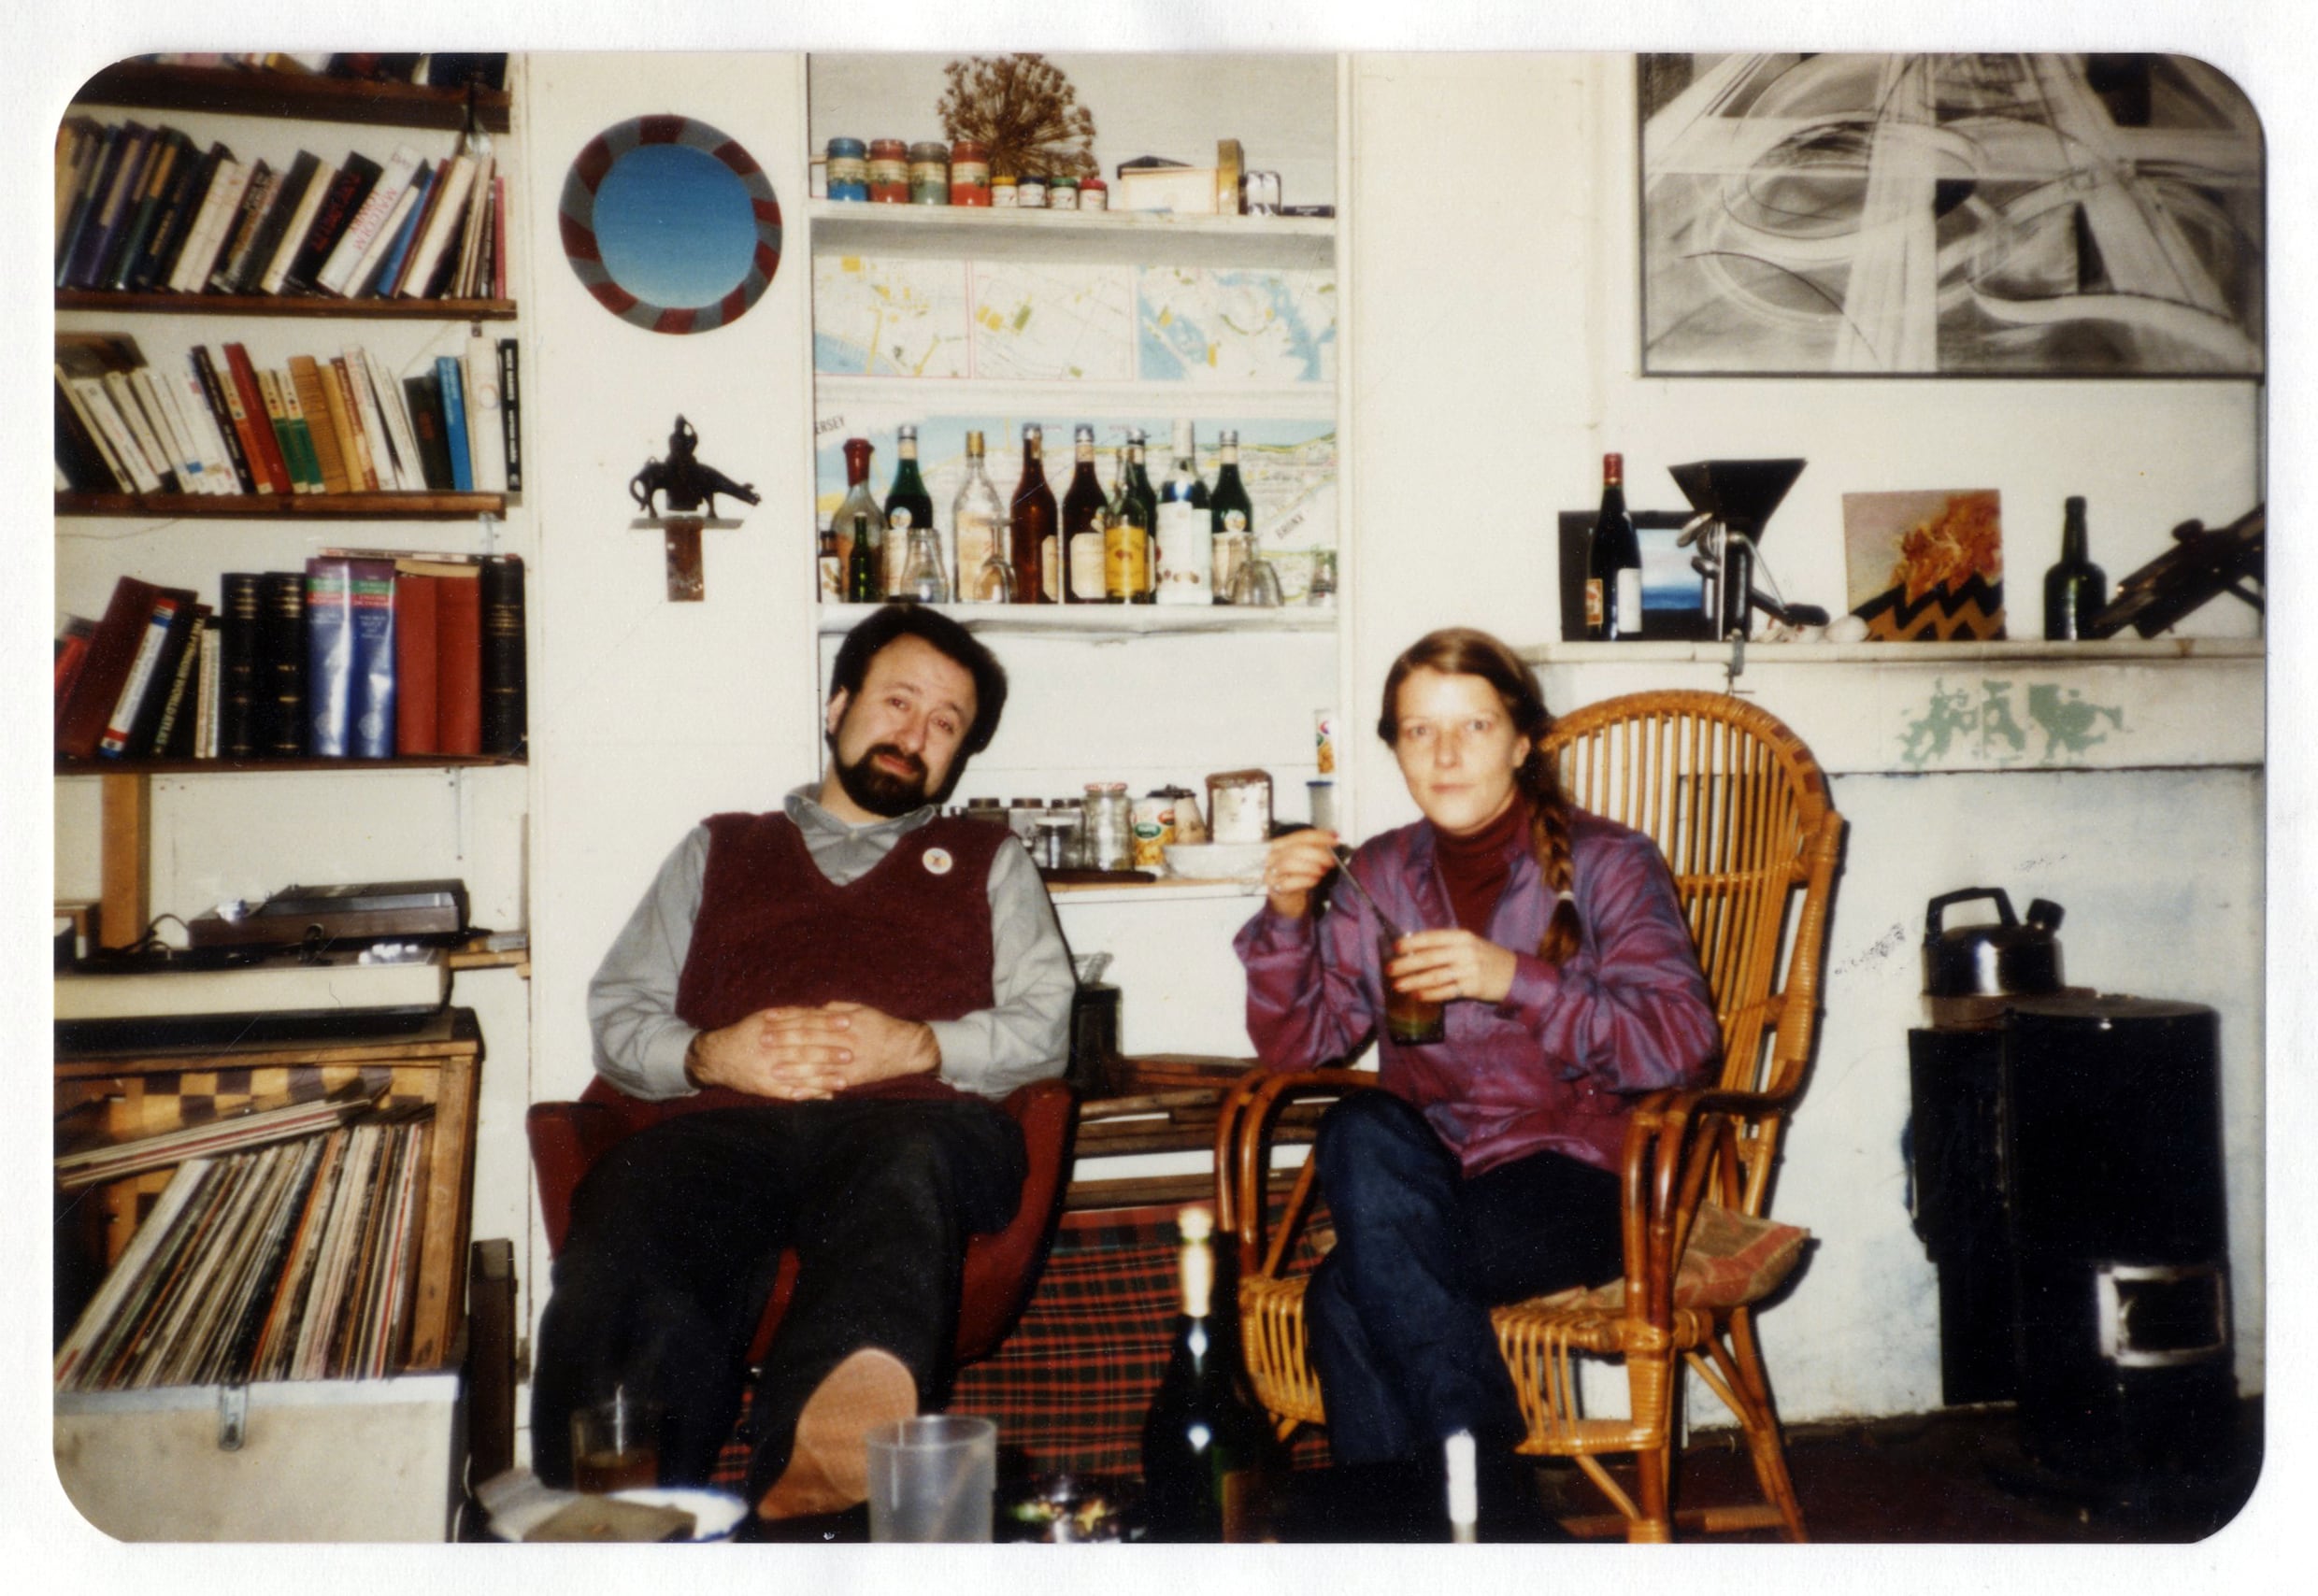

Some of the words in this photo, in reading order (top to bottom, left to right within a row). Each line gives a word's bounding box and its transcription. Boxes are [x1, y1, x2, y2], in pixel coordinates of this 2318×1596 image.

[353, 187, 398, 251] MALCOLM
[1275, 513, 1306, 540] BRONX
[165, 677, 184, 716] WORLD
[155, 713, 174, 745] ATLAS
